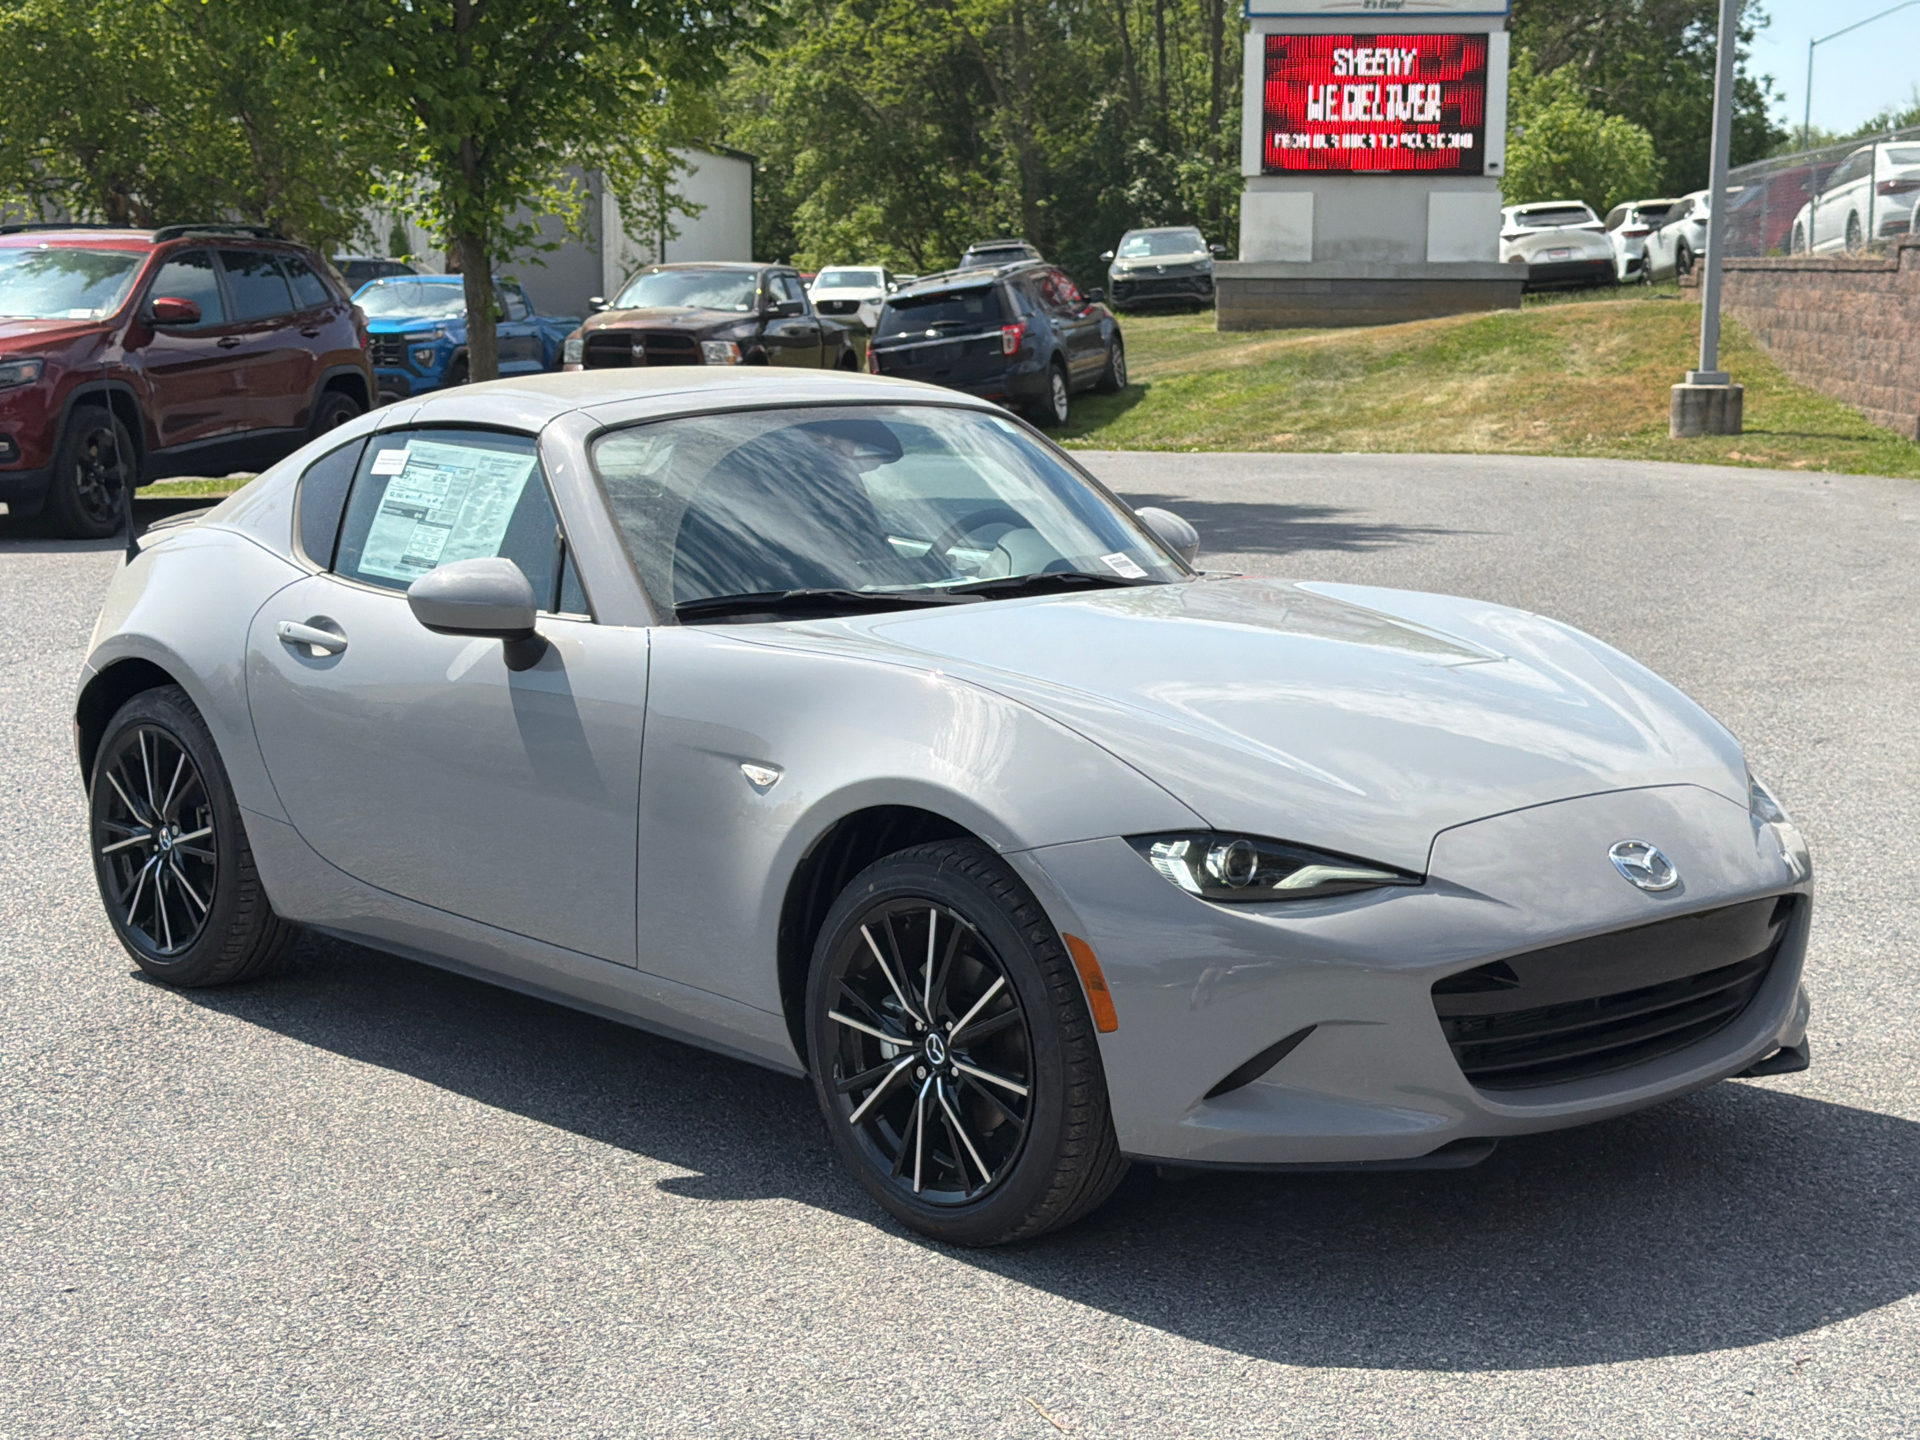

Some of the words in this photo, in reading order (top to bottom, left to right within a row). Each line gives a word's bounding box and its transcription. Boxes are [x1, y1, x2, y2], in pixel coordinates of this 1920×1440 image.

[1333, 47, 1417, 76] SHEEHY
[1307, 83, 1340, 121] WE
[1341, 83, 1441, 122] DELIVER
